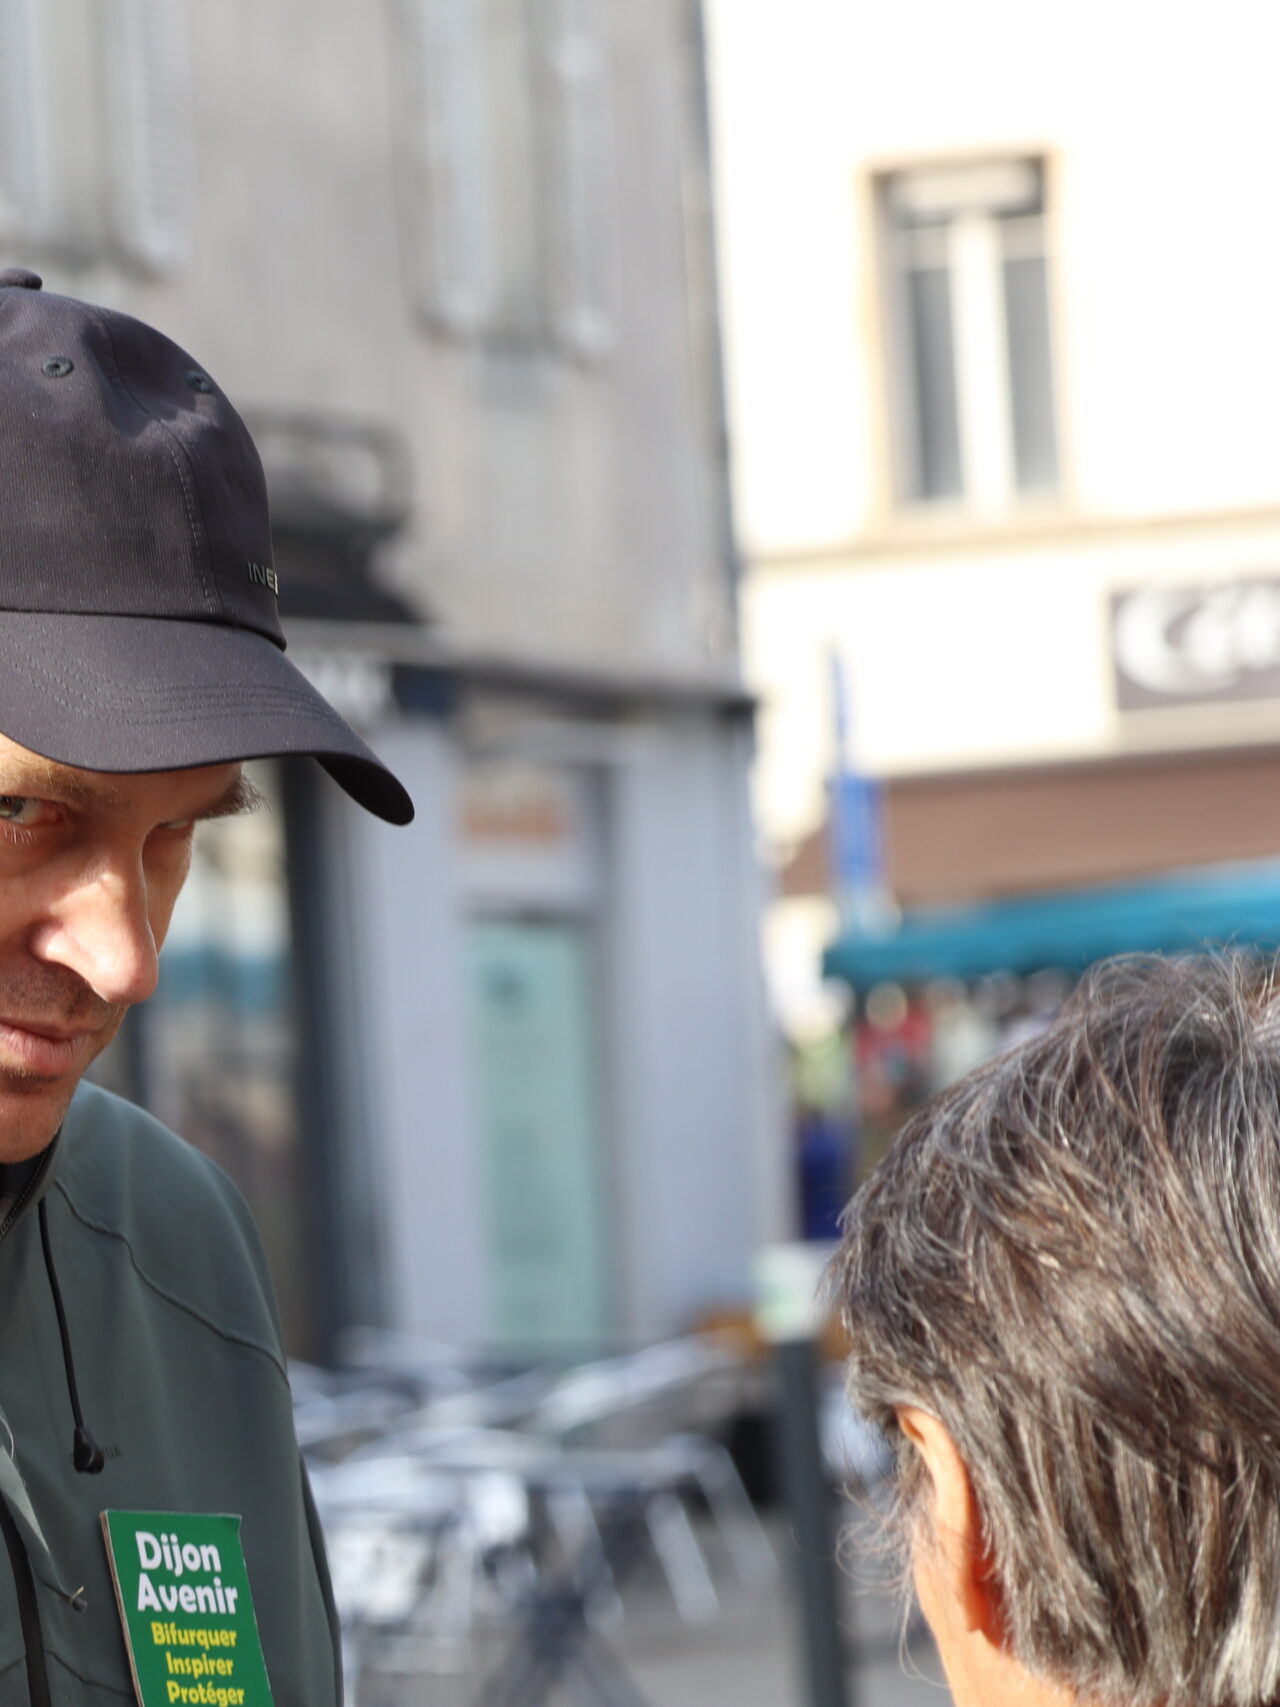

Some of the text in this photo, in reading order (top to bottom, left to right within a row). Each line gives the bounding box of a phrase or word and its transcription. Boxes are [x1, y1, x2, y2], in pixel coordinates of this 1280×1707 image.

[247, 561, 279, 595] INE
[135, 1530, 222, 1577] Dijon
[137, 1572, 238, 1615] Avenir
[150, 1621, 237, 1651] Bifurquer
[165, 1651, 234, 1680] Inspirer
[166, 1680, 245, 1707] Protéger
